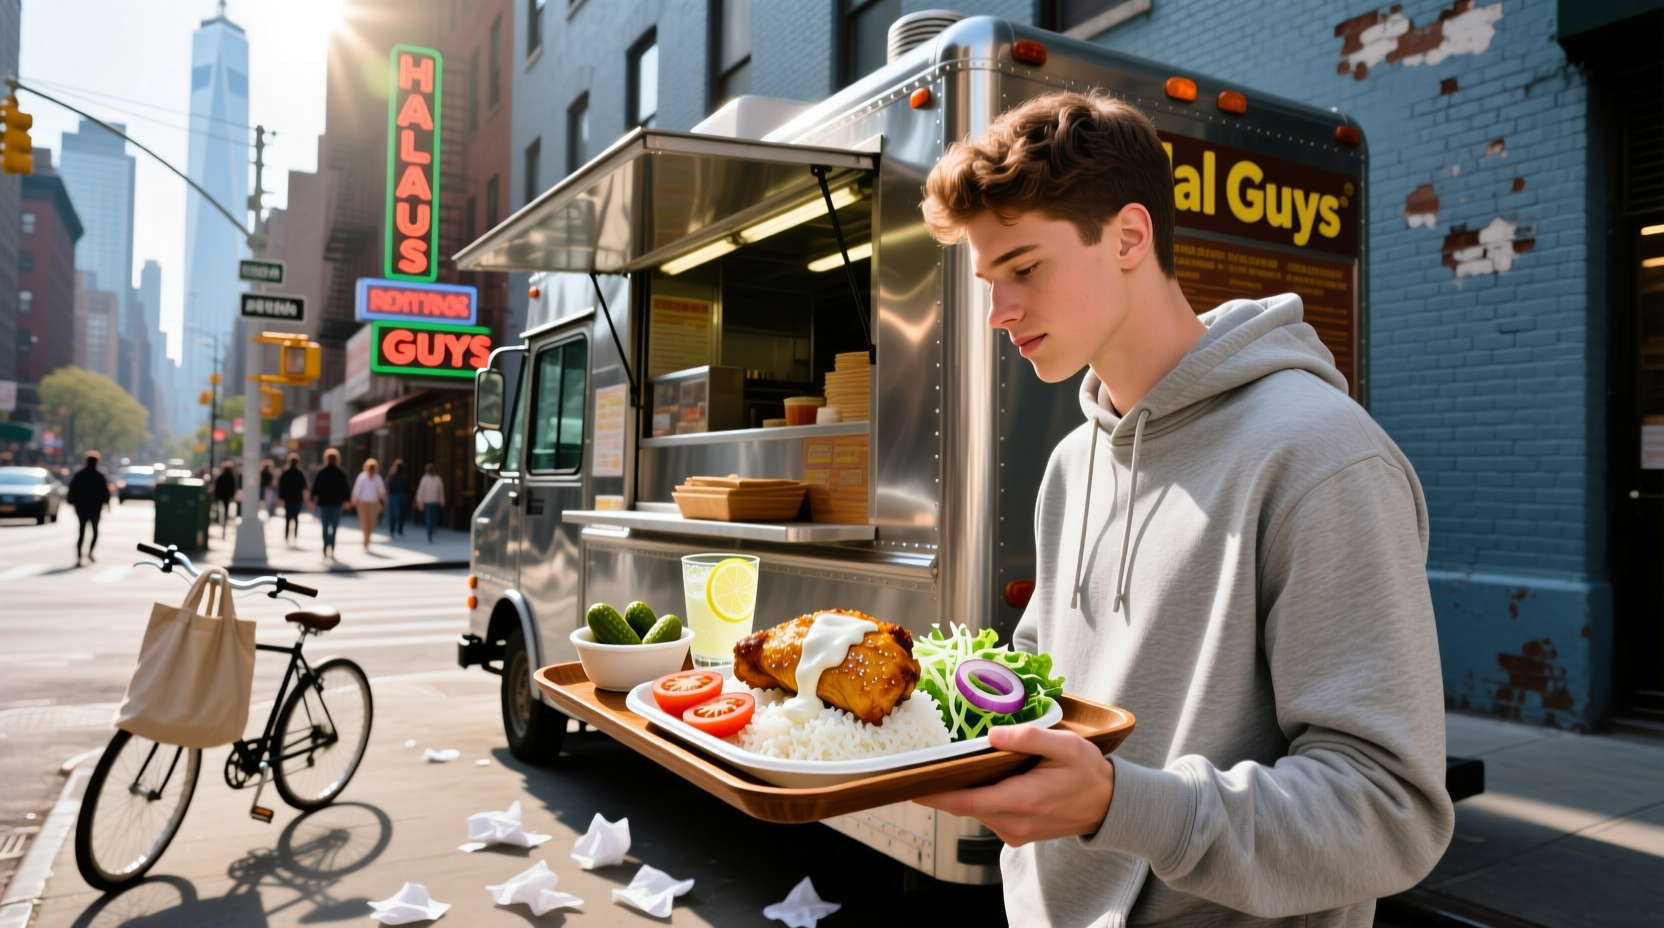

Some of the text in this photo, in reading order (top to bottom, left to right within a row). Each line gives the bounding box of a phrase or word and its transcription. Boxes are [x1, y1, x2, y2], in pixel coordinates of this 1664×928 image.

[395, 54, 434, 274] HALAUS
[1226, 160, 1341, 246] Guys
[382, 329, 492, 369] GUYS
